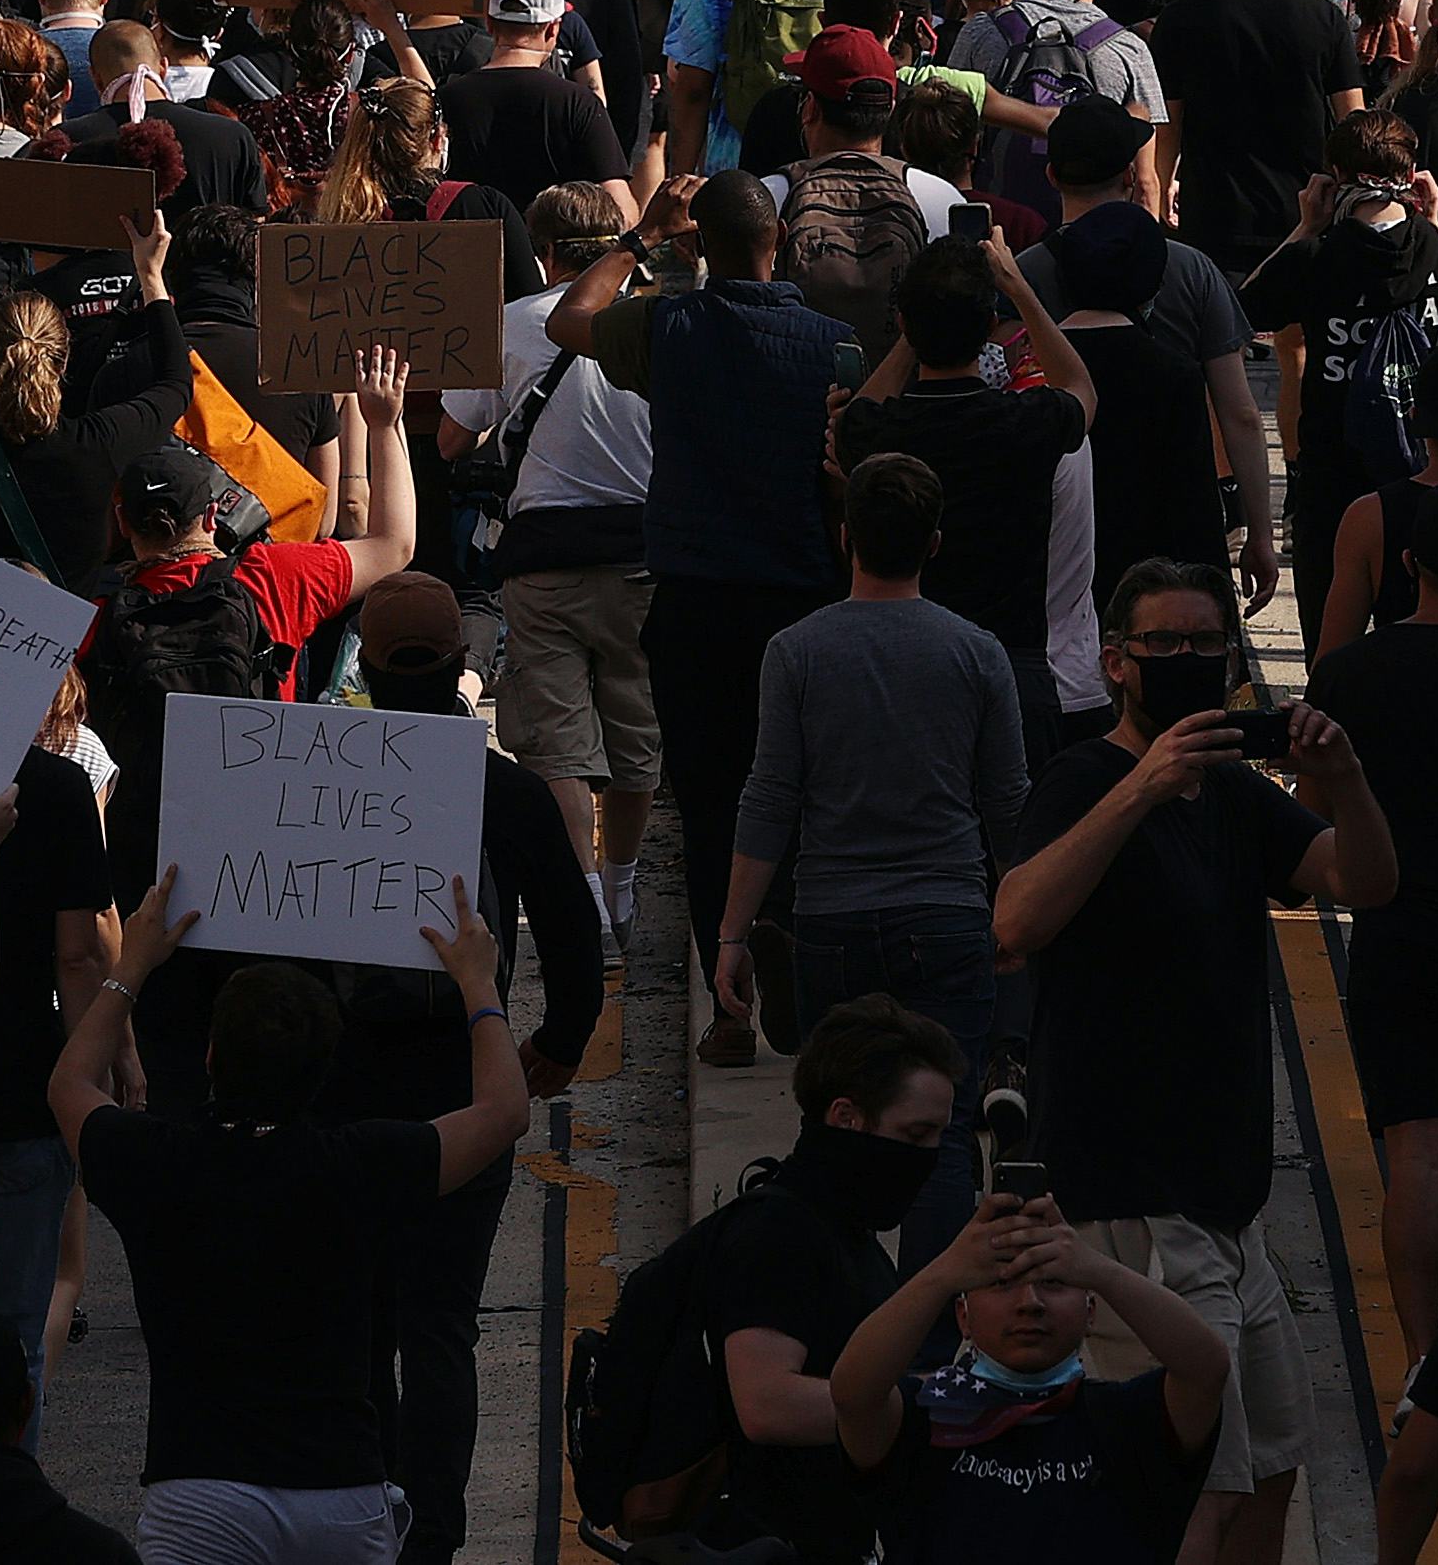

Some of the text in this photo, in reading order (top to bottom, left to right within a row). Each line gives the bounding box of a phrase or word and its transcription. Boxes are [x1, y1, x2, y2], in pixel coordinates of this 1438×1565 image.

[284, 232, 447, 285] BLACK
[309, 281, 446, 322] LIVES
[220, 705, 419, 772] BLACK
[276, 781, 413, 835] LIVES
[210, 850, 457, 929] MATTER
[1037, 1458, 1051, 1484] is
